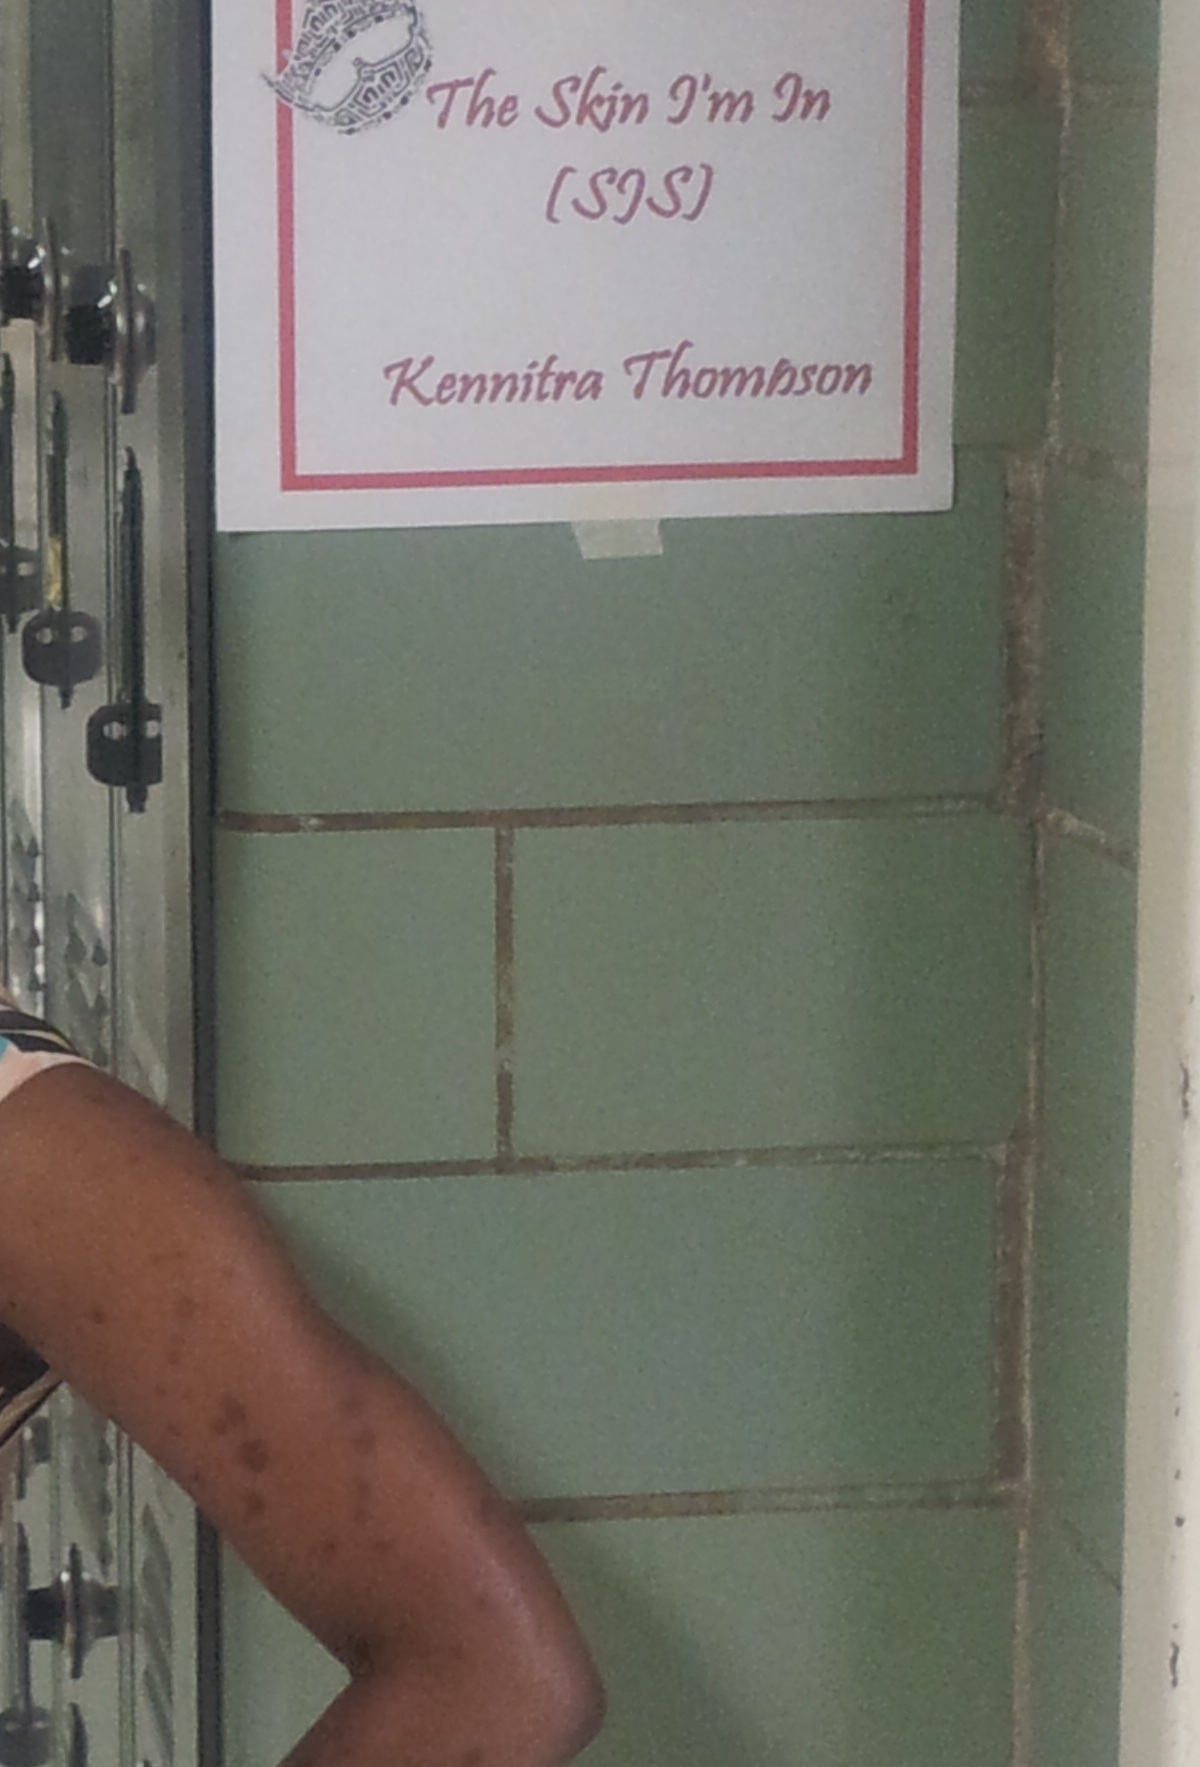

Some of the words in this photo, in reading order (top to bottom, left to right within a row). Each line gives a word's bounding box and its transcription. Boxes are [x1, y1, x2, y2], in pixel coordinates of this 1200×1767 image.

[426, 67, 519, 129] The
[534, 65, 649, 133] Skin
[667, 73, 755, 125] I'm
[772, 71, 832, 123] In
[382, 355, 604, 407] Kennitra
[622, 339, 874, 400] Thompson
